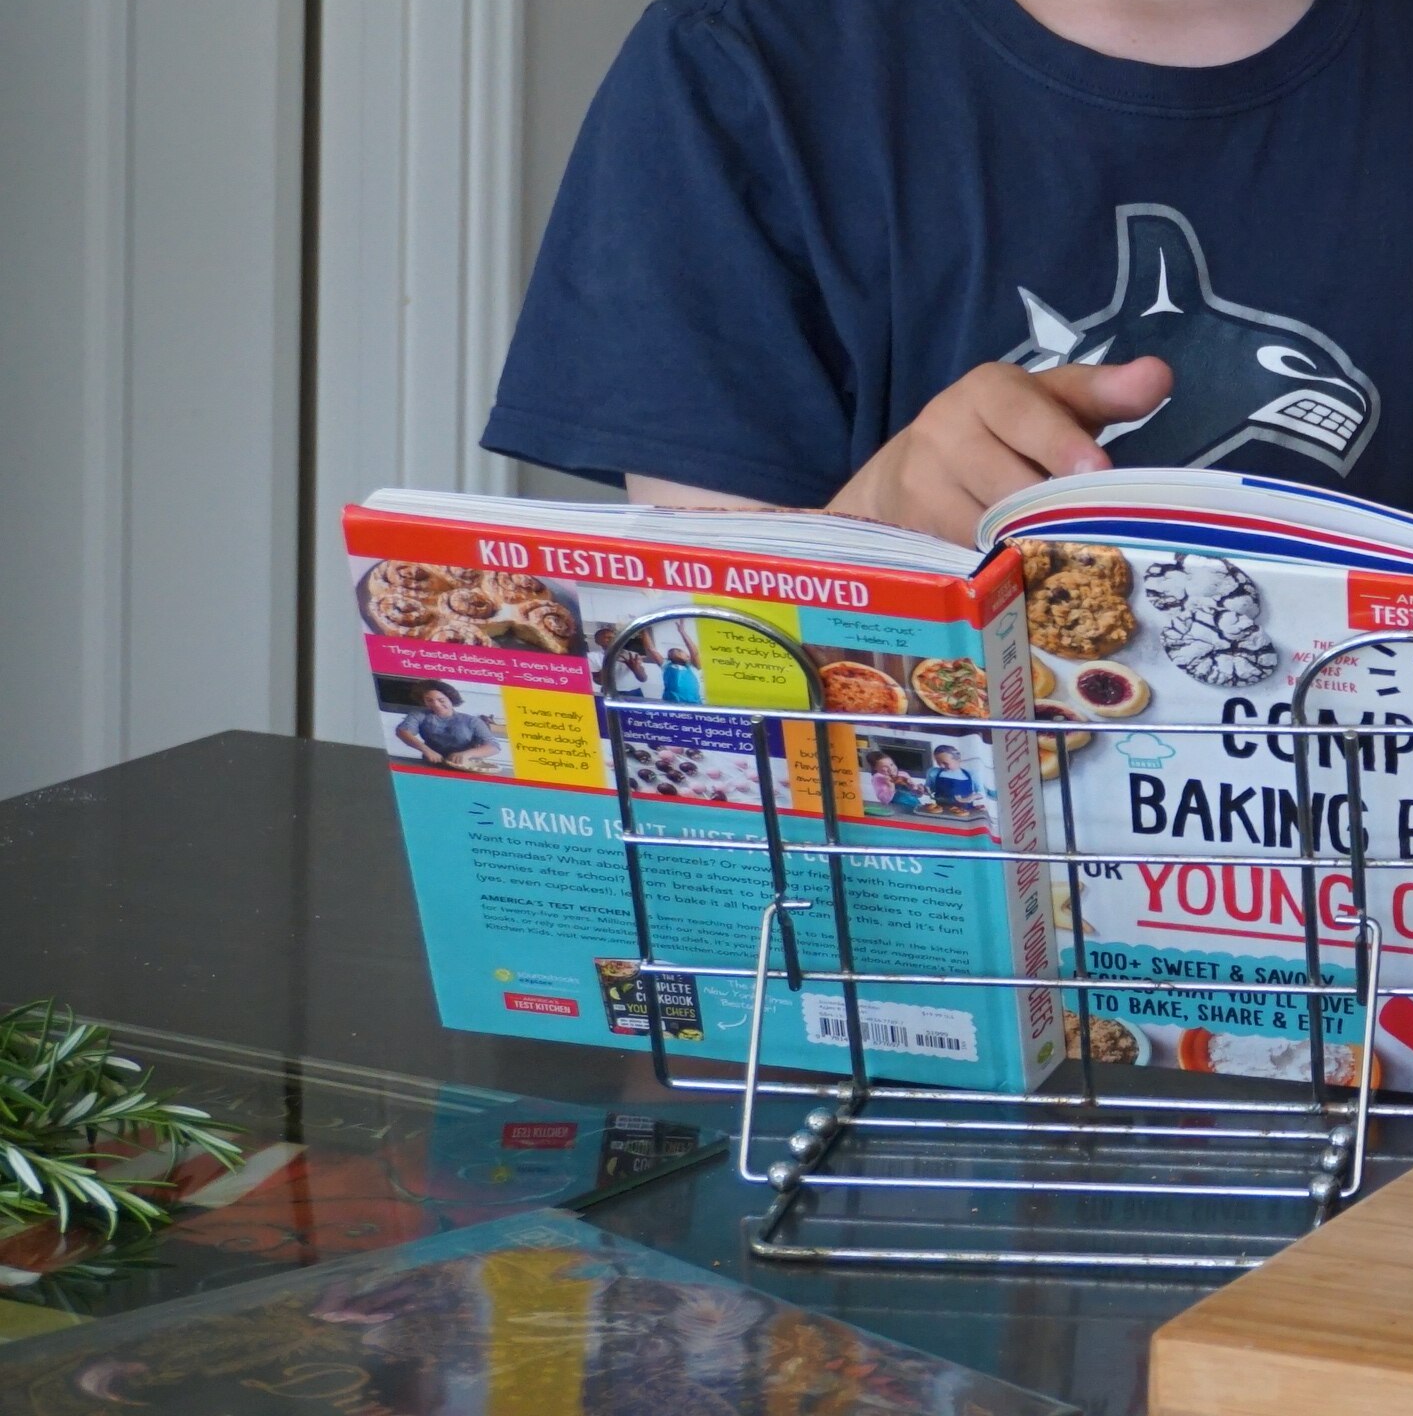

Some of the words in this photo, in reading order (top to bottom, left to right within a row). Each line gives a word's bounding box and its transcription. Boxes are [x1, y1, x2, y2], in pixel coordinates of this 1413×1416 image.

[478, 539, 529, 569] KID
[538, 546, 654, 587] TESTED,
[663, 559, 713, 590] KID
[725, 567, 869, 608] APPROVED
[896, 639, 909, 649] 12
[1001, 640, 1018, 669] THE
[401, 659, 421, 670] the
[423, 661, 455, 674] extra
[558, 676, 569, 686] 9
[418, 648, 457, 662] tasted
[518, 660, 548, 672] even
[550, 662, 583, 676] licked
[1334, 655, 1360, 667] ORK
[771, 674, 787, 685] 10
[524, 719, 566, 732] excited
[568, 724, 581, 733] to
[530, 708, 552, 717] was
[554, 711, 583, 723] really
[627, 718, 679, 731] fantastic
[681, 723, 702, 734] and
[704, 726, 733, 739] good
[695, 712, 727, 725] made
[728, 715, 738, 725] it
[516, 744, 545, 754] from
[521, 732, 554, 743] make
[557, 735, 588, 748] dough
[623, 731, 678, 744] alentines."
[738, 741, 754, 752] 10
[580, 761, 589, 771] 8
[842, 791, 856, 800] 10
[1008, 766, 1037, 845] BAKING
[501, 807, 593, 837] BAKING
[1128, 773, 1370, 856] BAKING
[468, 832, 503, 844] Want
[506, 836, 521, 846] to
[525, 838, 560, 850] make
[563, 843, 592, 856] your
[596, 847, 624, 857] own
[657, 854, 716, 868] pretzels?
[720, 860, 739, 870] Or
[741, 864, 772, 874] wow
[856, 876, 885, 887] with
[888, 879, 962, 896] homemade
[471, 848, 553, 863] empanadas?
[556, 855, 592, 868] What
[596, 861, 630, 872] abou
[803, 883, 830, 894] pie?
[883, 893, 919, 904] some
[922, 895, 963, 911] chewy
[474, 859, 534, 874] brownies
[539, 867, 570, 878] after
[577, 870, 626, 884] school?
[673, 881, 733, 897] breakfast
[740, 888, 754, 898] to
[853, 902, 903, 915] cookies
[908, 909, 922, 918] to
[928, 911, 965, 923] cakes
[510, 877, 540, 887] even
[656, 893, 671, 902] to
[675, 894, 706, 906] bake
[710, 899, 720, 907] it
[723, 900, 738, 909] all
[808, 911, 831, 920] can
[856, 915, 883, 927] this,
[887, 919, 912, 929] and
[916, 922, 935, 932] it's
[938, 924, 963, 935] fun!
[1024, 891, 1039, 920] FOR
[1138, 862, 1359, 932] YOUNG
[480, 894, 544, 908] AMERICA'S
[548, 901, 575, 911] TEST
[580, 905, 631, 917] KITCHEN
[910, 942, 926, 951] the
[931, 945, 969, 956] kitchen
[950, 957, 970, 966] and
[1090, 950, 1142, 972] 100+
[1152, 956, 1221, 981] SWEET
[1229, 965, 1245, 983] &
[1255, 968, 1335, 986] SAVOY
[514, 1000, 536, 1011] TEST
[536, 1002, 572, 1014] KITCHEN
[665, 1007, 696, 1018] CHEFS
[1028, 986, 1054, 1040] CHEFS
[1092, 993, 1119, 1012] TO
[1129, 996, 1189, 1021] BAKE,
[1198, 1004, 1265, 1028] SHARE
[1273, 1011, 1287, 1029] &
[1298, 1013, 1344, 1034] ET!
[1318, 997, 1355, 1015] OVE
